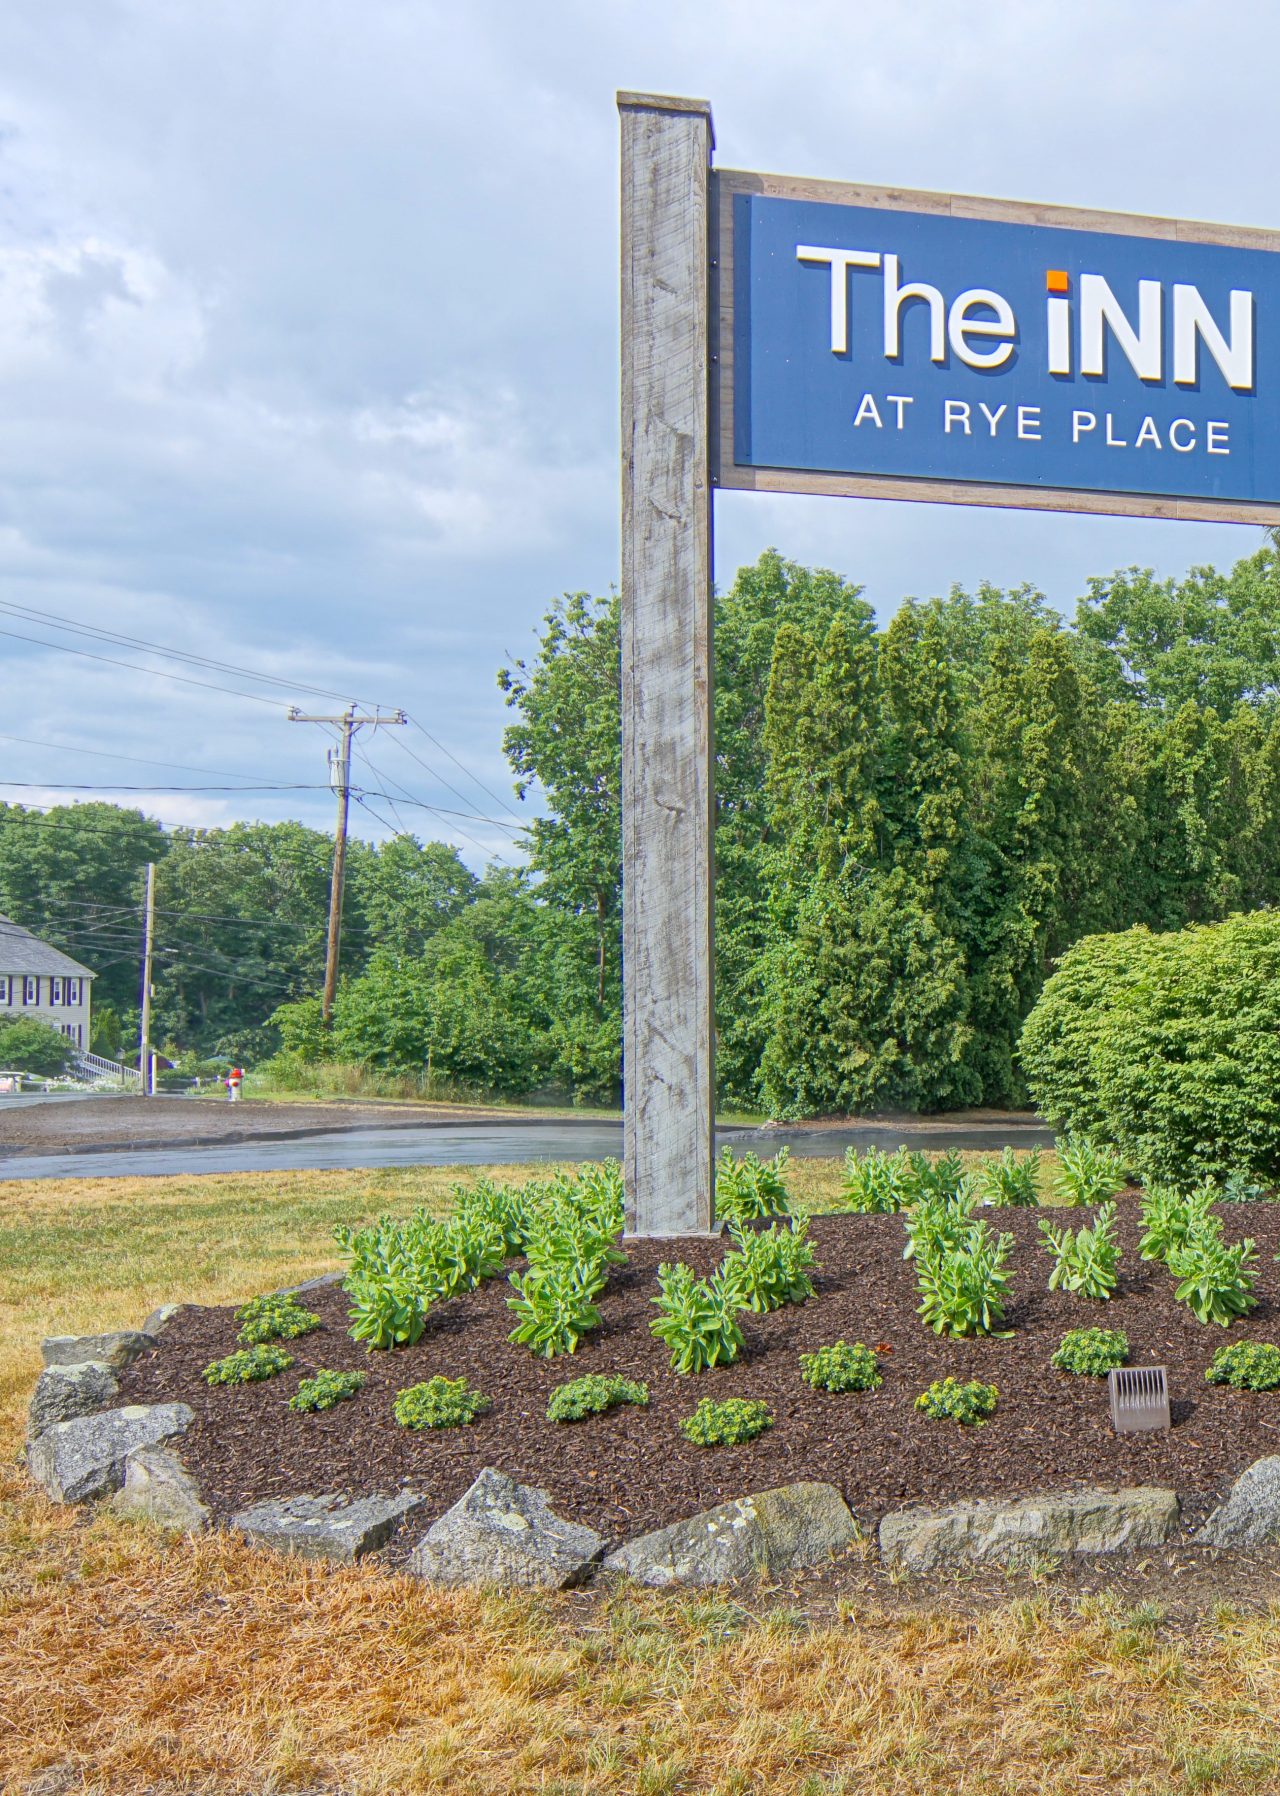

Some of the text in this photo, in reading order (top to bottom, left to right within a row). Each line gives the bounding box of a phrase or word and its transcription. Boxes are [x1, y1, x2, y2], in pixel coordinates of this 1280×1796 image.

[796, 245, 1253, 389] The iNN
[853, 393, 1231, 455] AT RYE PLACE
